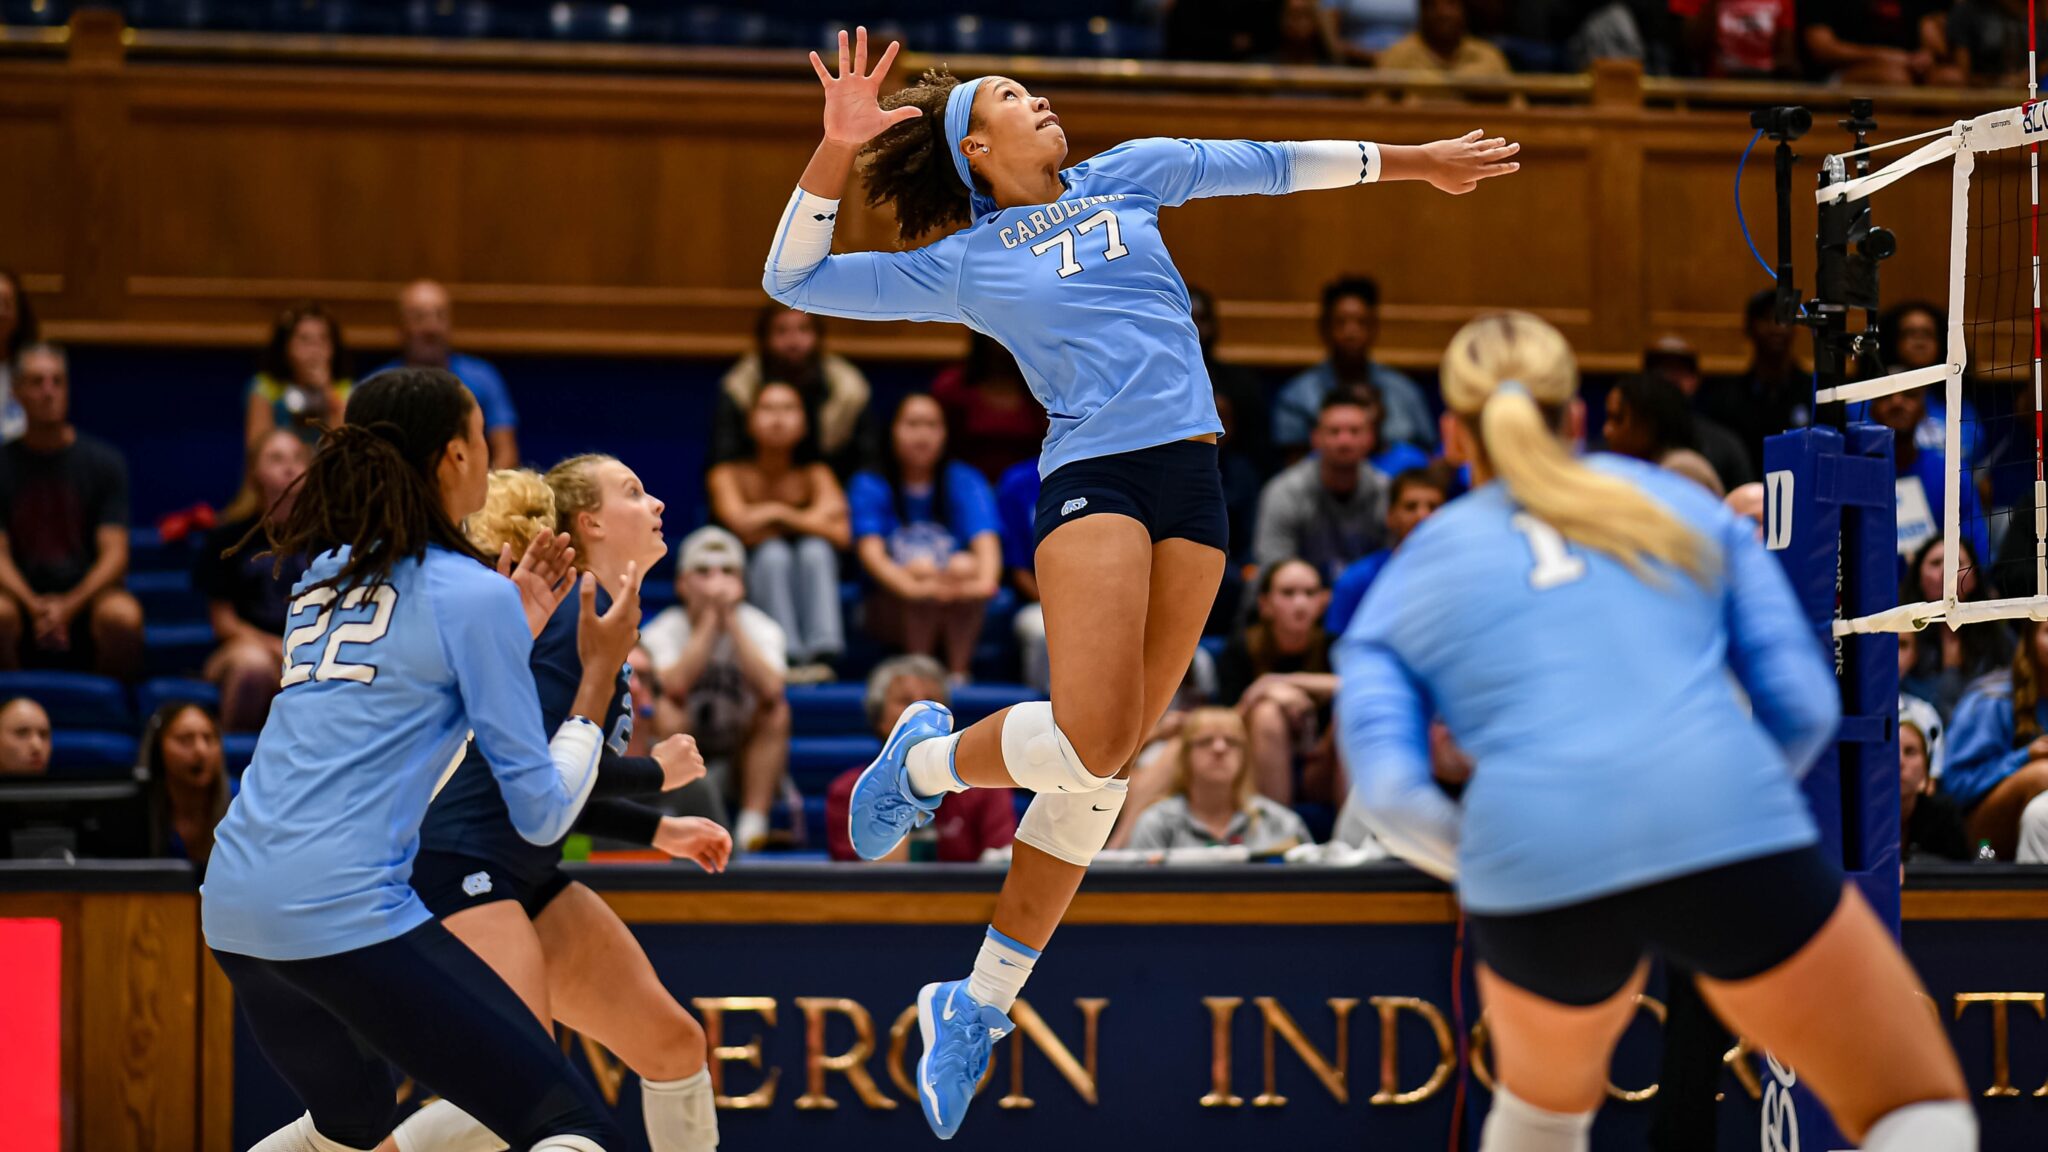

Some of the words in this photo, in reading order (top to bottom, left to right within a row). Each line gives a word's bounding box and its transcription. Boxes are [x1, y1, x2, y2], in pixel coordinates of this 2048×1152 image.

[1029, 208, 1131, 280] 77
[1765, 469, 1795, 551] D
[1512, 512, 1586, 591] 1
[279, 583, 400, 690] 22
